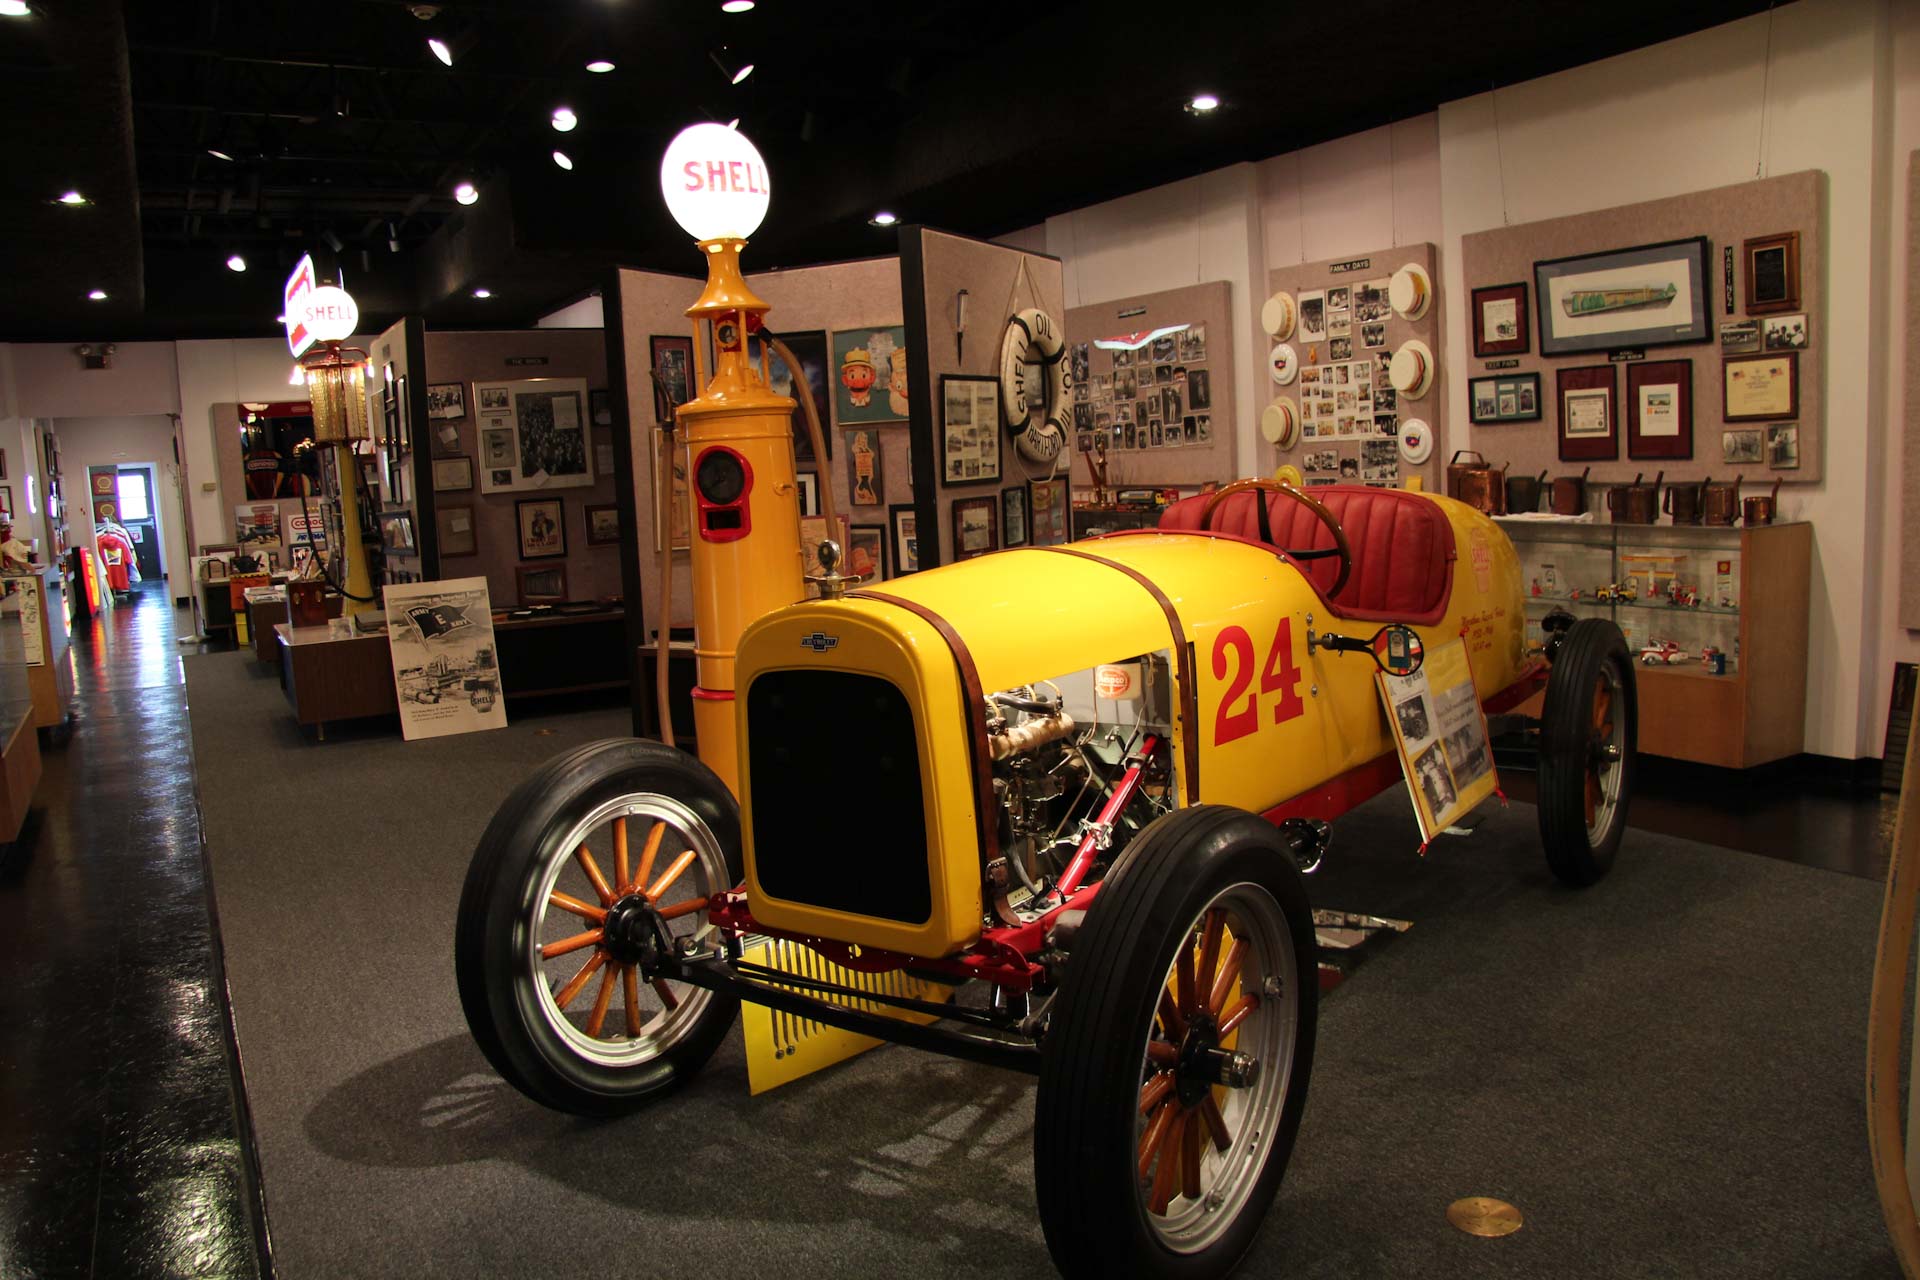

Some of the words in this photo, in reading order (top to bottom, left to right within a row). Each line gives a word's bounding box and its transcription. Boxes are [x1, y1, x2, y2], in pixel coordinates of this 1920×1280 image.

[683, 161, 768, 195] SHELL
[1330, 264, 1351, 273] FAMILY
[1352, 260, 1369, 270] DAYS
[306, 305, 352, 321] SHELL
[1015, 340, 1028, 413] SHELL
[1036, 313, 1053, 341] OIL
[1061, 357, 1073, 394] CO.
[411, 608, 429, 617] ARMY
[435, 614, 446, 626] E
[1212, 616, 1304, 747] 24
